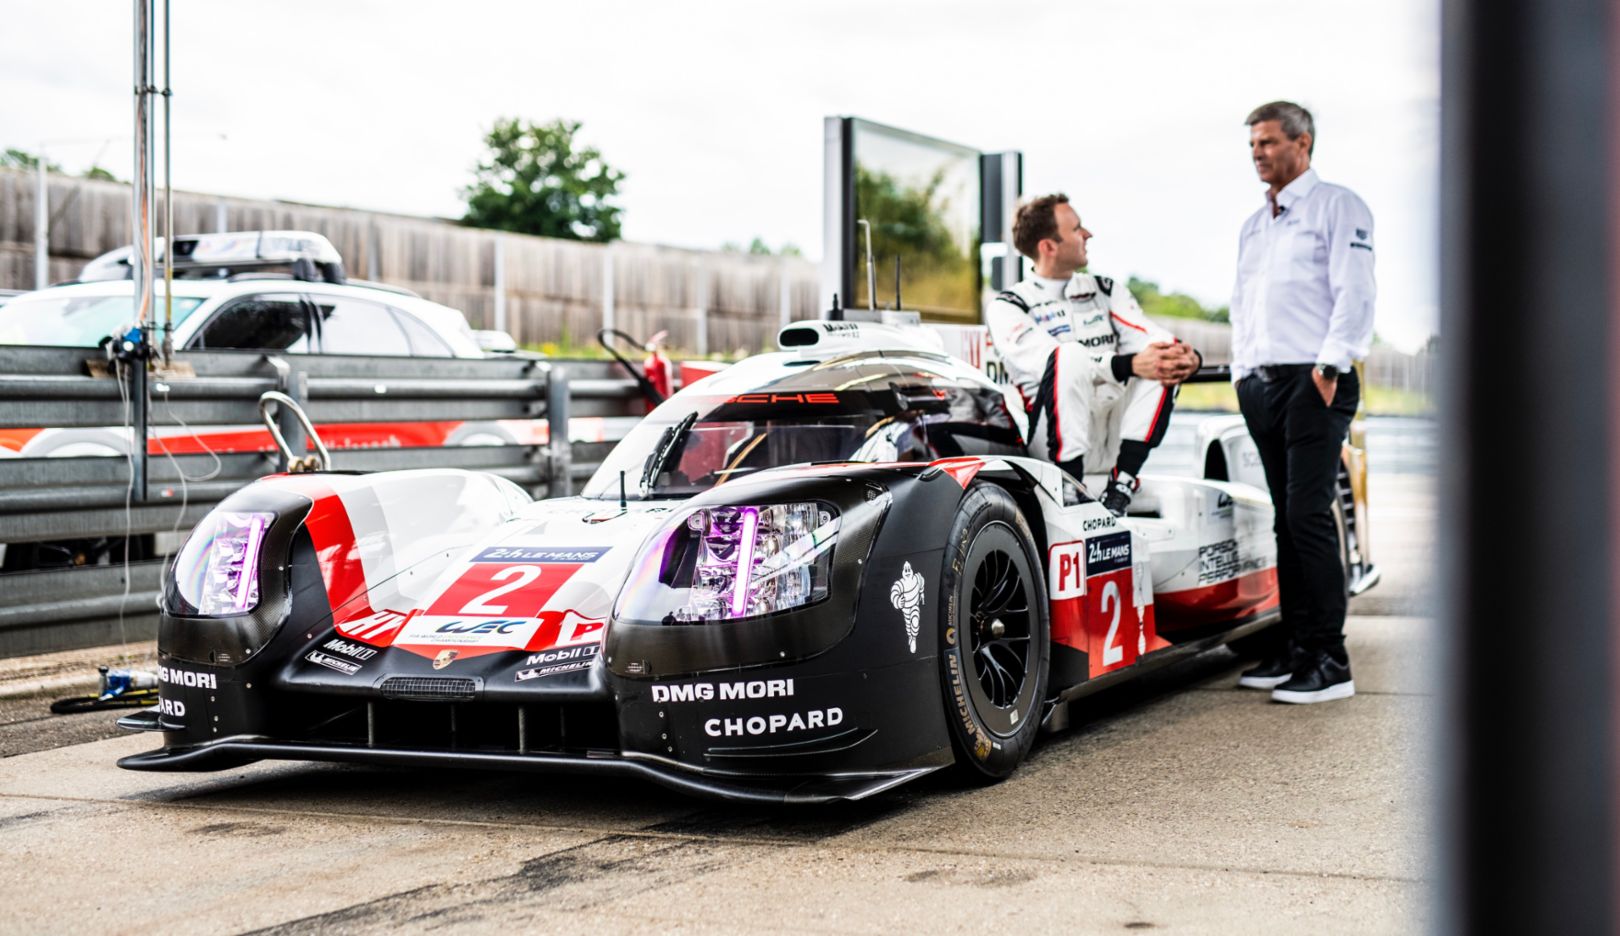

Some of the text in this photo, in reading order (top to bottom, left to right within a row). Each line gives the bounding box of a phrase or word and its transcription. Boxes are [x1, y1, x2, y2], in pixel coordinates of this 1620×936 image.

[1083, 516, 1117, 531] CHOPARD
[1059, 551, 1081, 592] P1
[459, 564, 541, 615] 2
[435, 620, 527, 634] WEC
[1101, 580, 1123, 667] 2
[323, 639, 363, 657] Mobil
[526, 648, 582, 666] Mobil
[170, 668, 217, 689] MORI
[651, 679, 794, 702] DMG MORI
[949, 654, 976, 736] MICHELIN
[704, 707, 843, 737] CHOPARD
